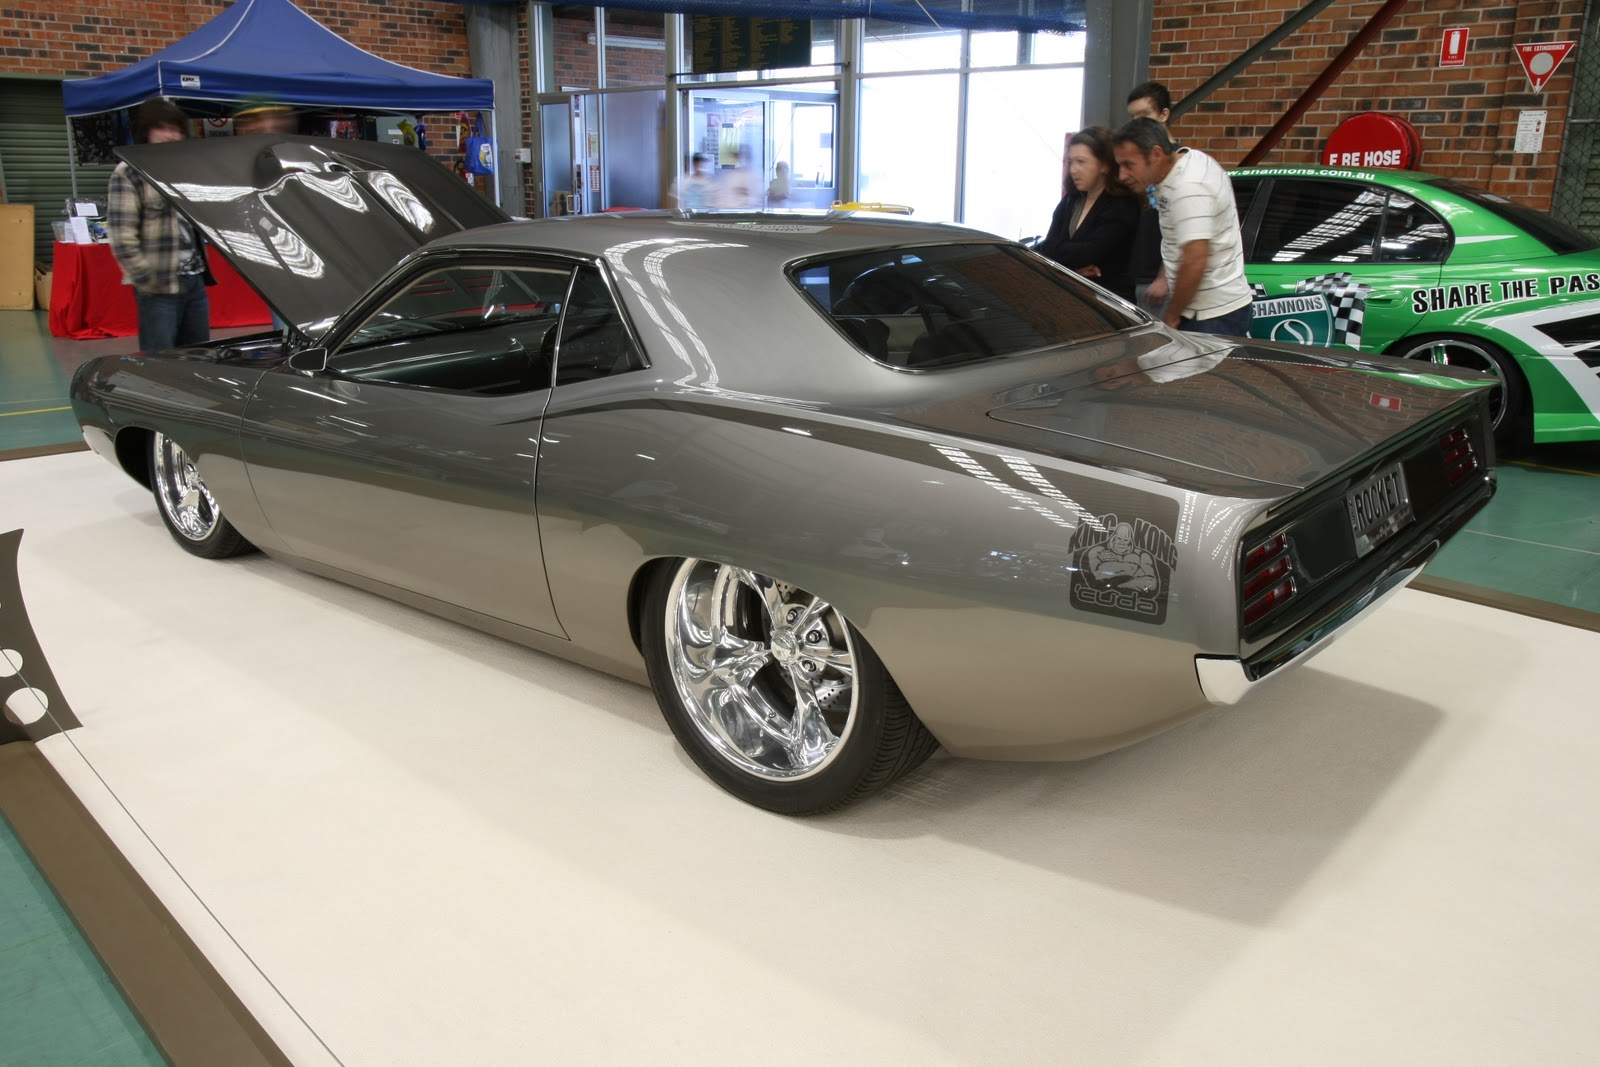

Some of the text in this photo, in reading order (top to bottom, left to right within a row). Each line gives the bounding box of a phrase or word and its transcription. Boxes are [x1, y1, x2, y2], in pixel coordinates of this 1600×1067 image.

[1329, 149, 1401, 167] FRE HOSE
[1412, 273, 1600, 314] SHARE THE PAS
[1353, 472, 1399, 532] ROCKET
[1134, 518, 1178, 572] KONG
